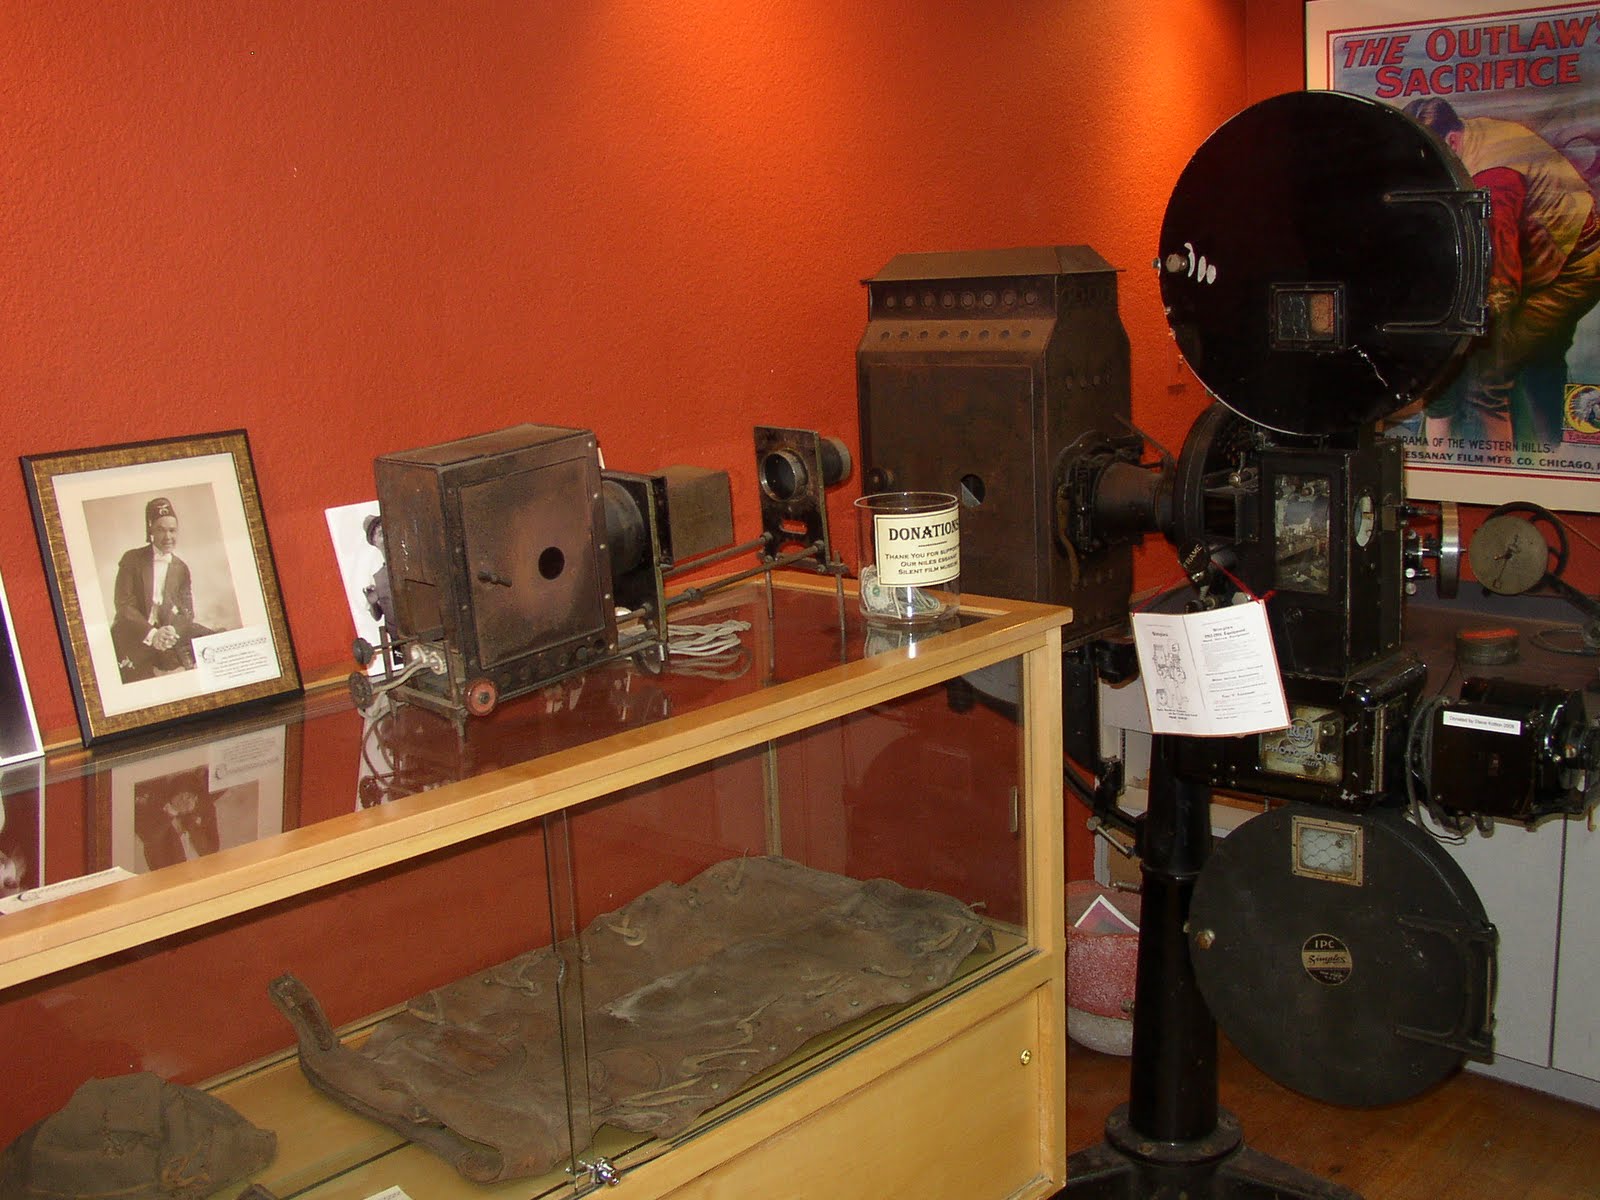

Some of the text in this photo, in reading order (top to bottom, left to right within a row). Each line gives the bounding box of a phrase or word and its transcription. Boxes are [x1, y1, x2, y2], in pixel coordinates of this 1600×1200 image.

[1342, 35, 1411, 68] THE
[1375, 53, 1581, 98] SACRIFICE
[1432, 437, 1444, 448] OF
[1448, 438, 1465, 449] THE
[1469, 439, 1518, 451] WESTERN
[1521, 441, 1555, 454] HILLS.
[1405, 450, 1452, 461] ESSANAY
[1457, 452, 1484, 463] FILM
[1517, 456, 1534, 466] CO.
[1539, 458, 1594, 471] CHICAGO,
